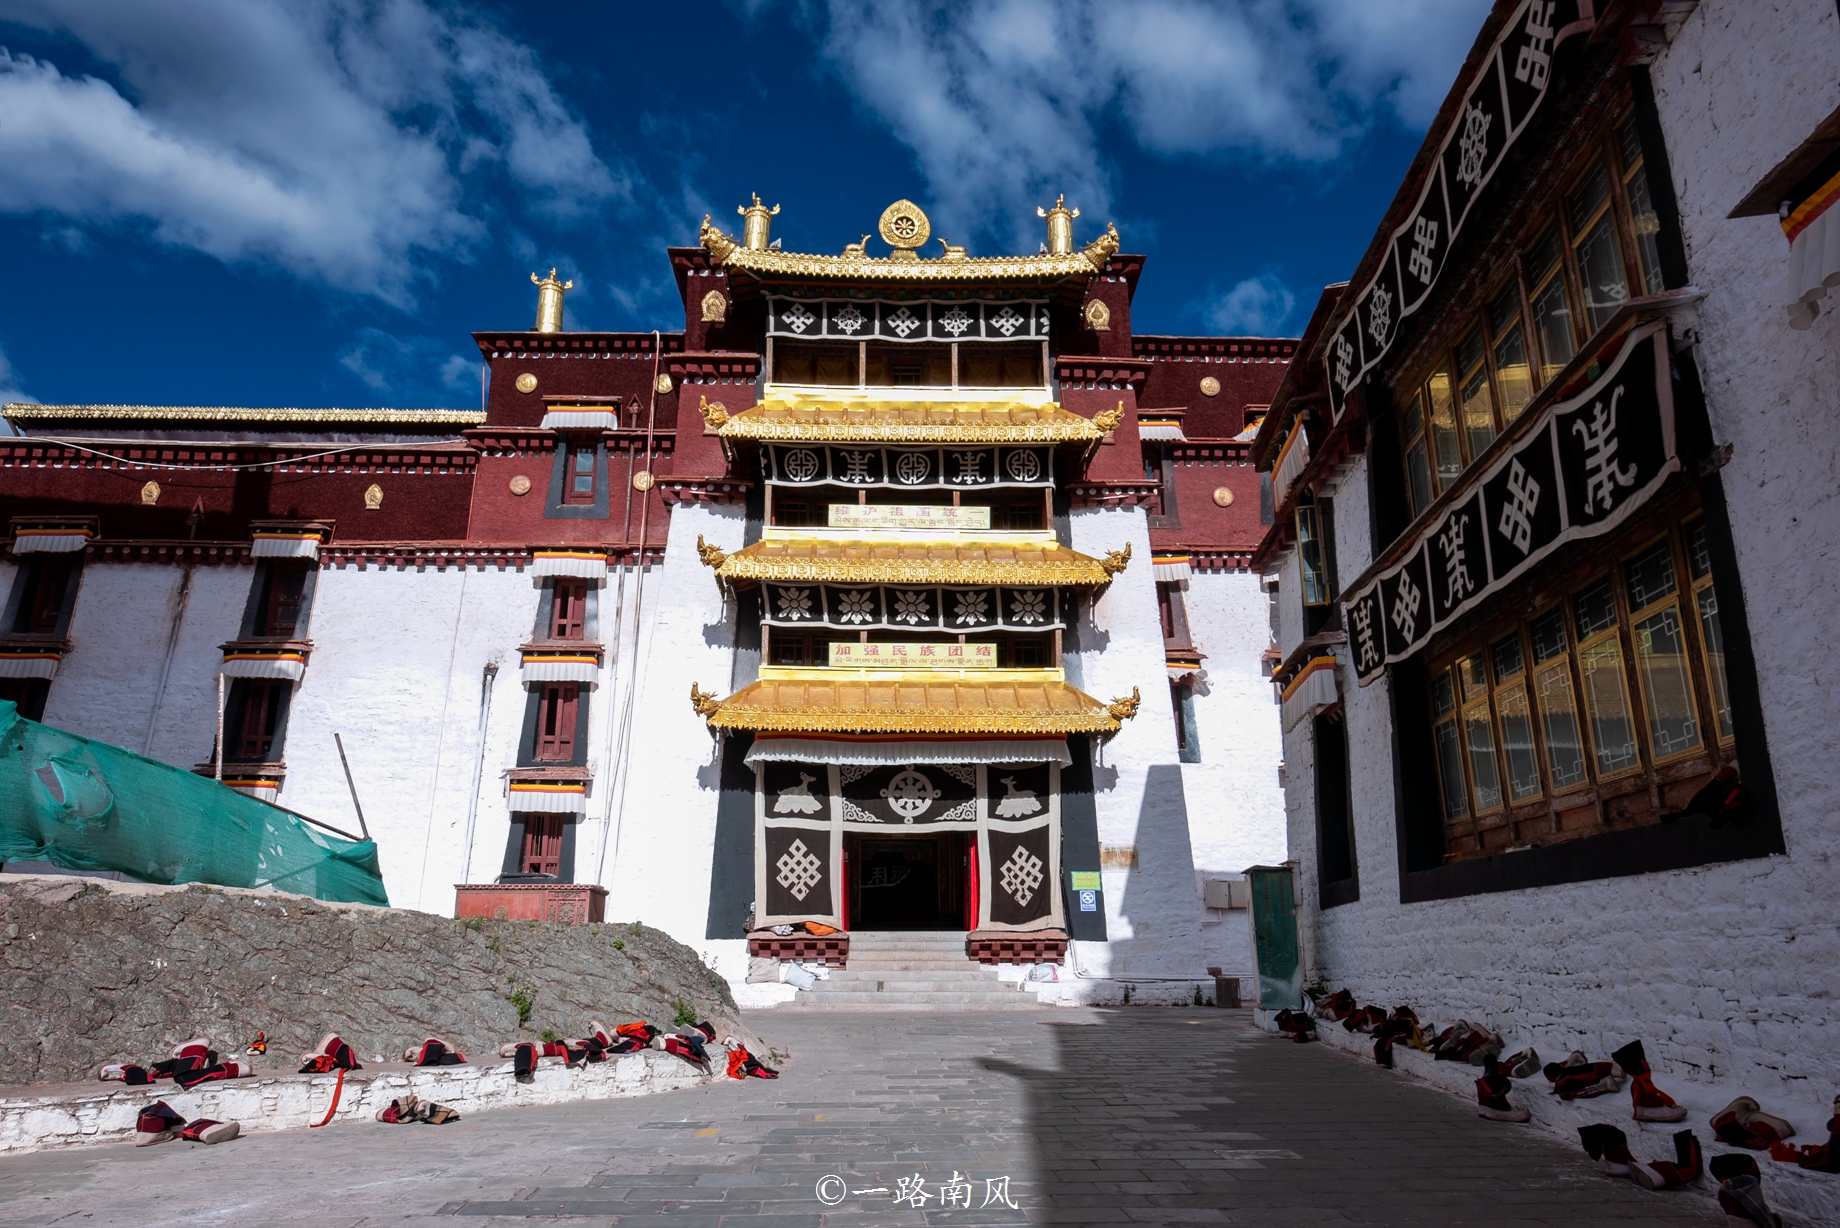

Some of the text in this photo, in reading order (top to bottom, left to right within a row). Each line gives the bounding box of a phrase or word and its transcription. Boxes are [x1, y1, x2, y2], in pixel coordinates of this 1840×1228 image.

[835, 506, 984, 517] 维护祖国统一
[835, 645, 991, 656] 加强民族团结
